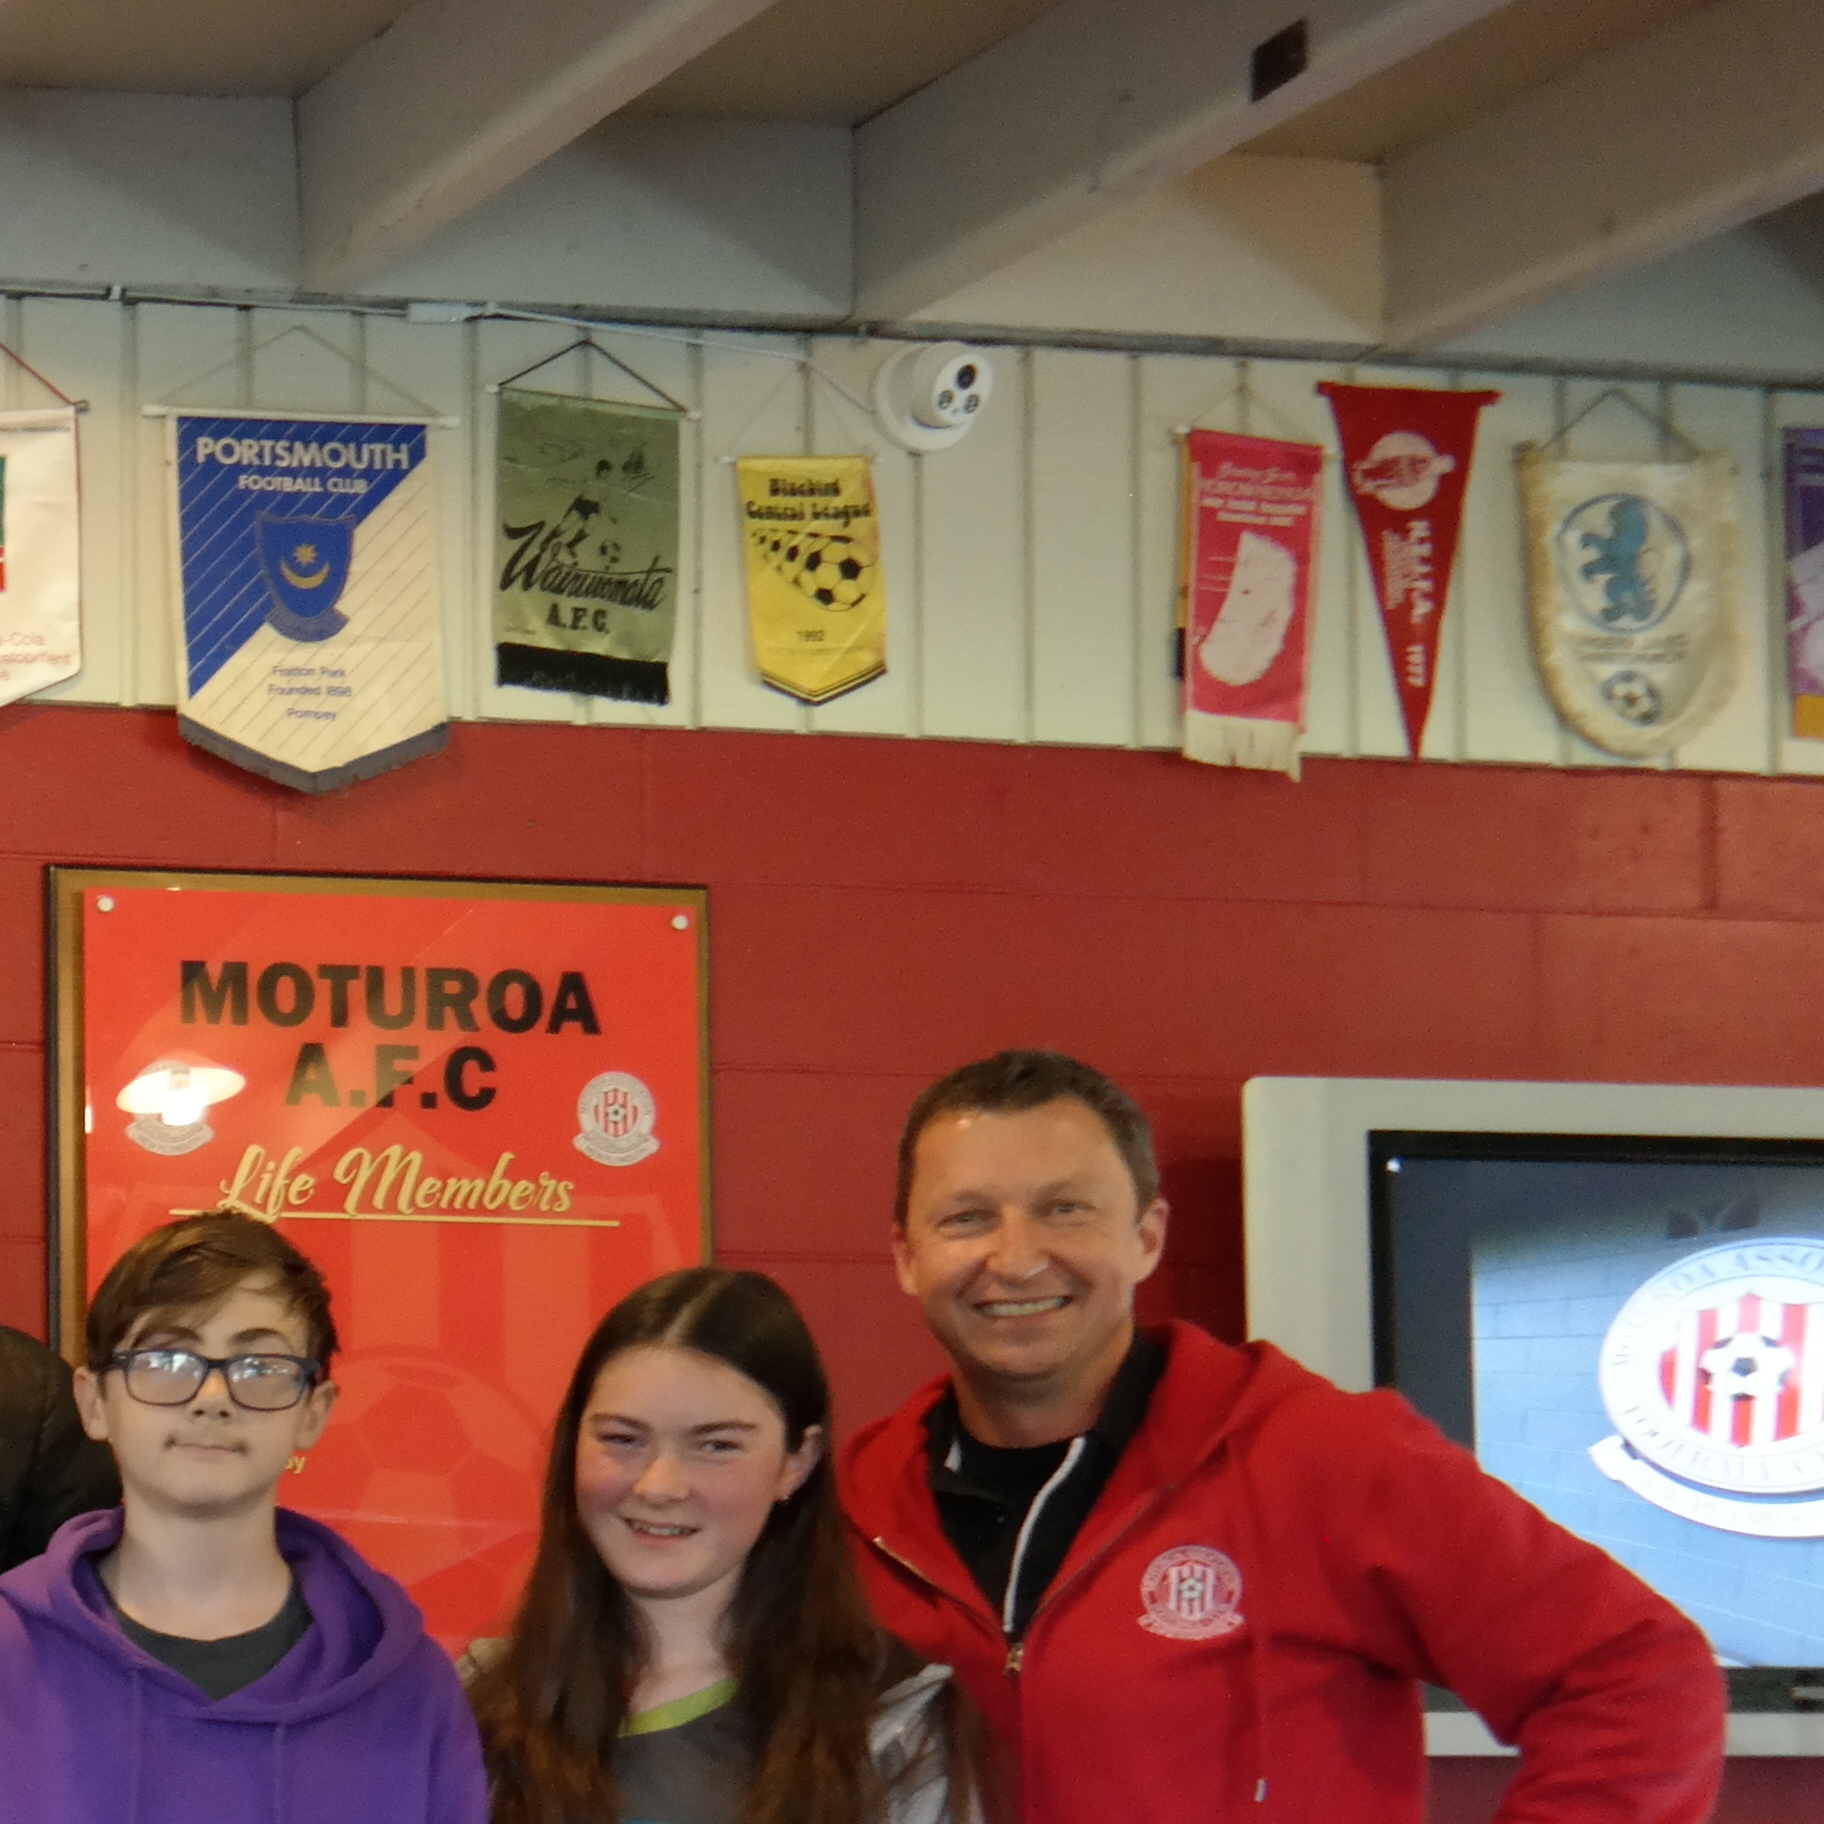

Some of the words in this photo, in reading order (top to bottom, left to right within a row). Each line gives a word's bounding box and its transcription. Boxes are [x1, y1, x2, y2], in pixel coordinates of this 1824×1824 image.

[195, 436, 411, 471] PORTSMOUTH
[238, 474, 324, 492] FOOTBALL
[326, 476, 370, 494] CLUB
[746, 500, 805, 521] Central
[811, 502, 872, 528] League
[271, 666, 316, 678] Fratton
[320, 666, 347, 679] Park
[268, 684, 321, 696] Founded
[286, 707, 337, 722] Pompey
[178, 959, 602, 1035] MOTUROA
[284, 1042, 497, 1111] A.F.C
[217, 1144, 316, 1224] Life
[333, 1144, 575, 1217] Members
